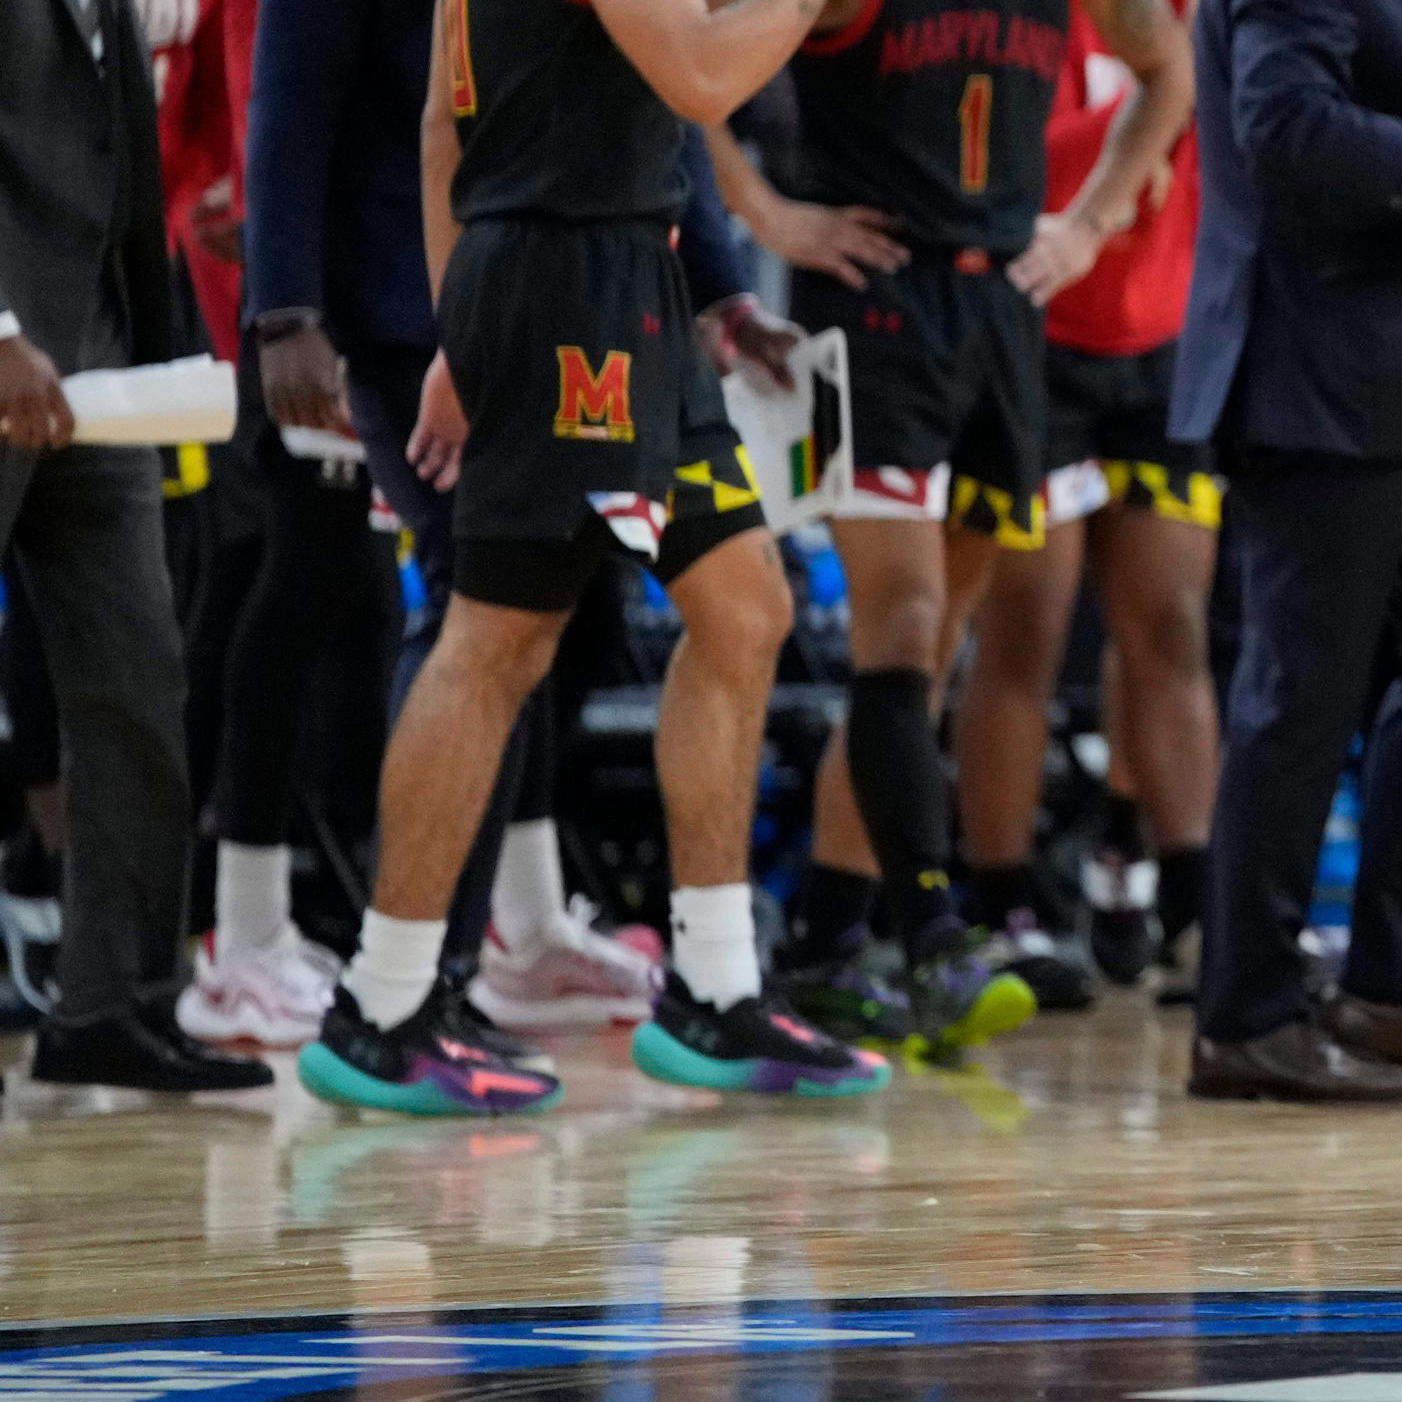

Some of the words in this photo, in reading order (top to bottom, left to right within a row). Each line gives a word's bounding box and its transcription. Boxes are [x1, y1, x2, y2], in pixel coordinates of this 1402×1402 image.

[878, 8, 1070, 81] MARYLAND
[957, 73, 994, 195] 1
[554, 345, 635, 442] M
